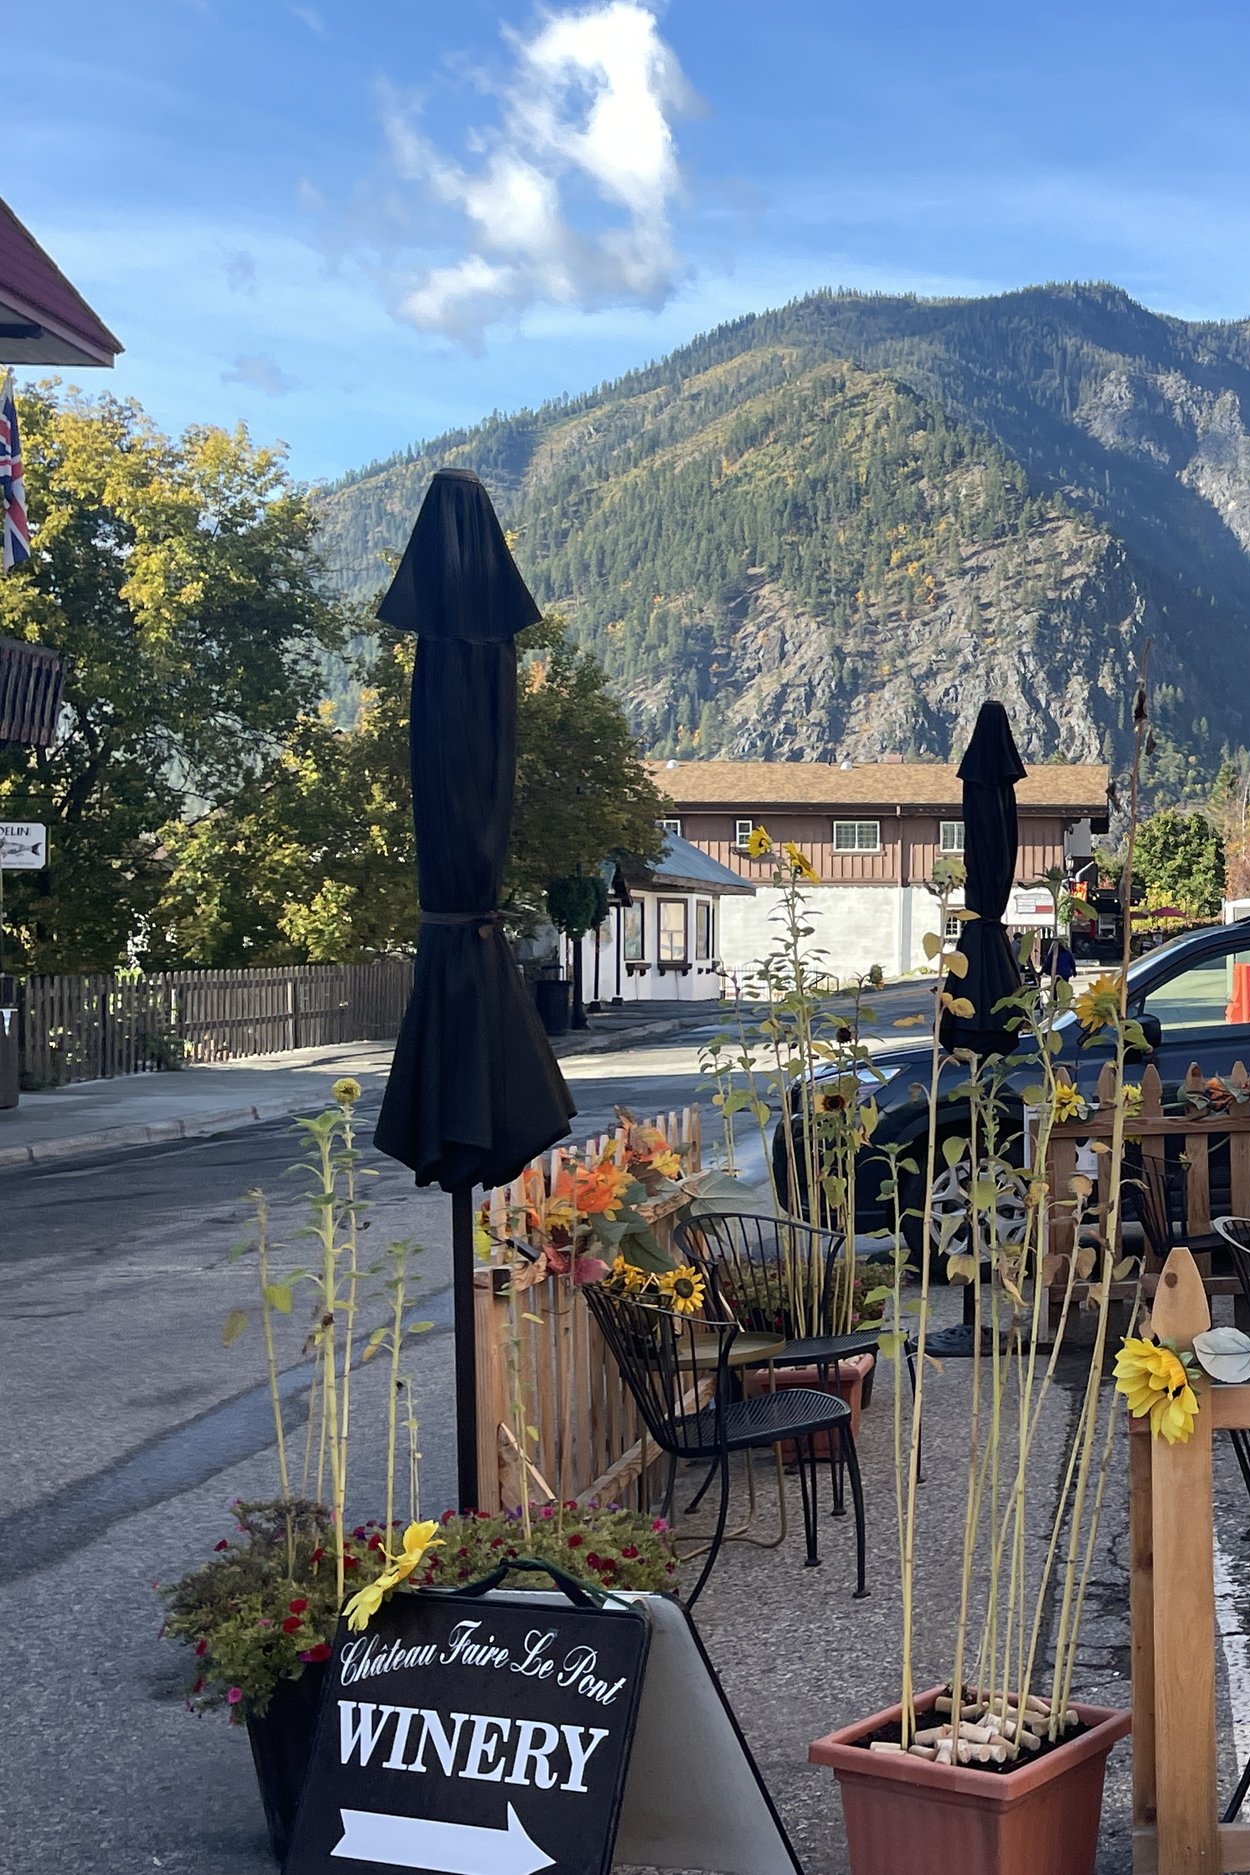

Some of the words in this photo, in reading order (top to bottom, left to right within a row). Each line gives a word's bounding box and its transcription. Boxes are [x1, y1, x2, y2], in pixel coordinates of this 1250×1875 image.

[340, 1634, 437, 1686] Château
[440, 1620, 509, 1668] Faire
[510, 1629, 554, 1680] Le
[557, 1645, 627, 1706] Pont
[337, 1699, 610, 1793] WINERY
